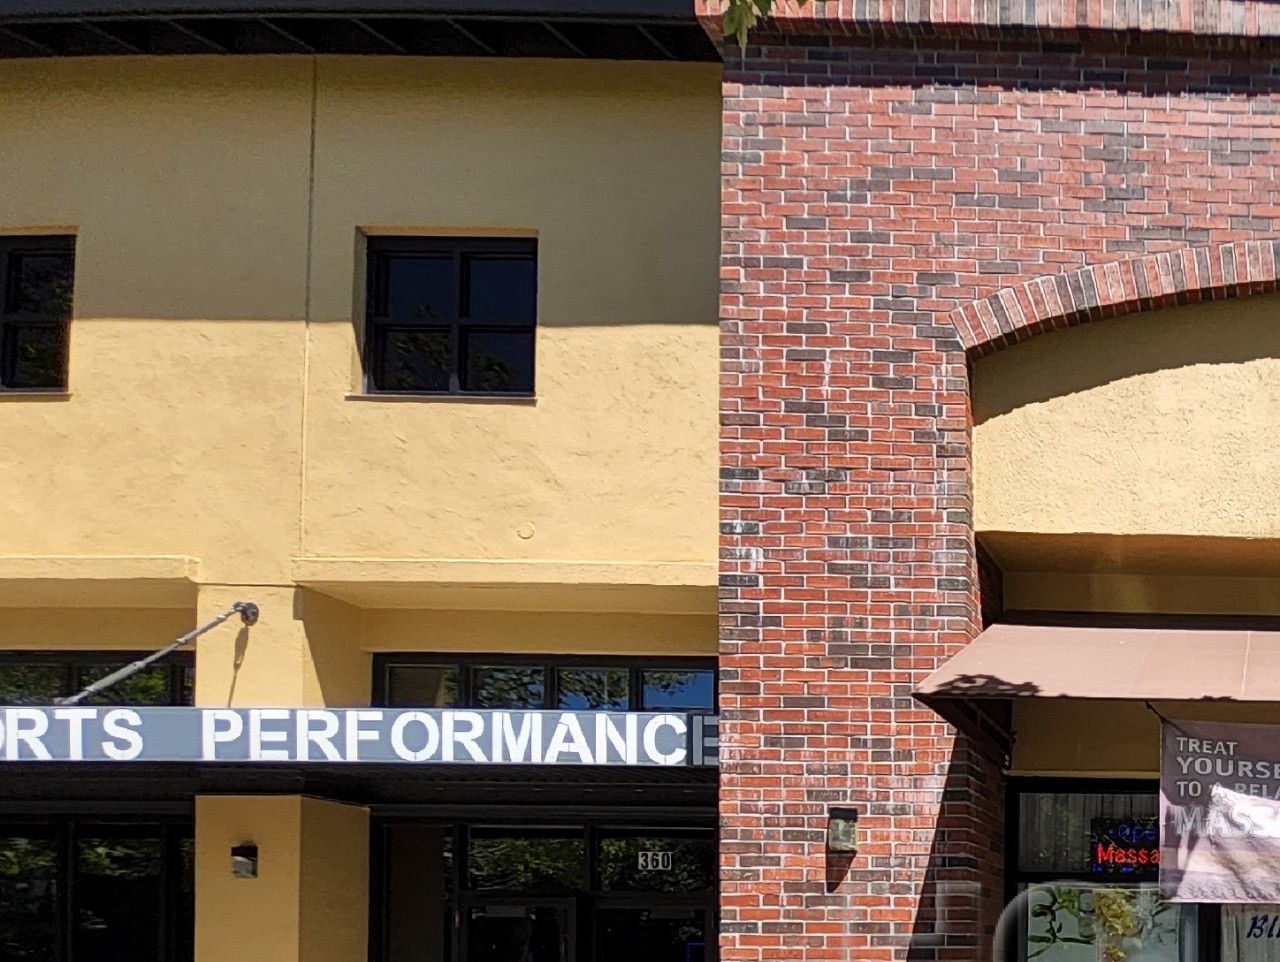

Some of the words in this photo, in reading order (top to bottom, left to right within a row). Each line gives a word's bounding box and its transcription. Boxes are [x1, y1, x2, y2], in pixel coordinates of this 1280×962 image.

[0, 707, 144, 761] RTS
[201, 708, 719, 766] PERFORMANCE
[1176, 736, 1238, 756] TREAT
[1176, 781, 1202, 797] TO
[640, 852, 671, 870] 360
